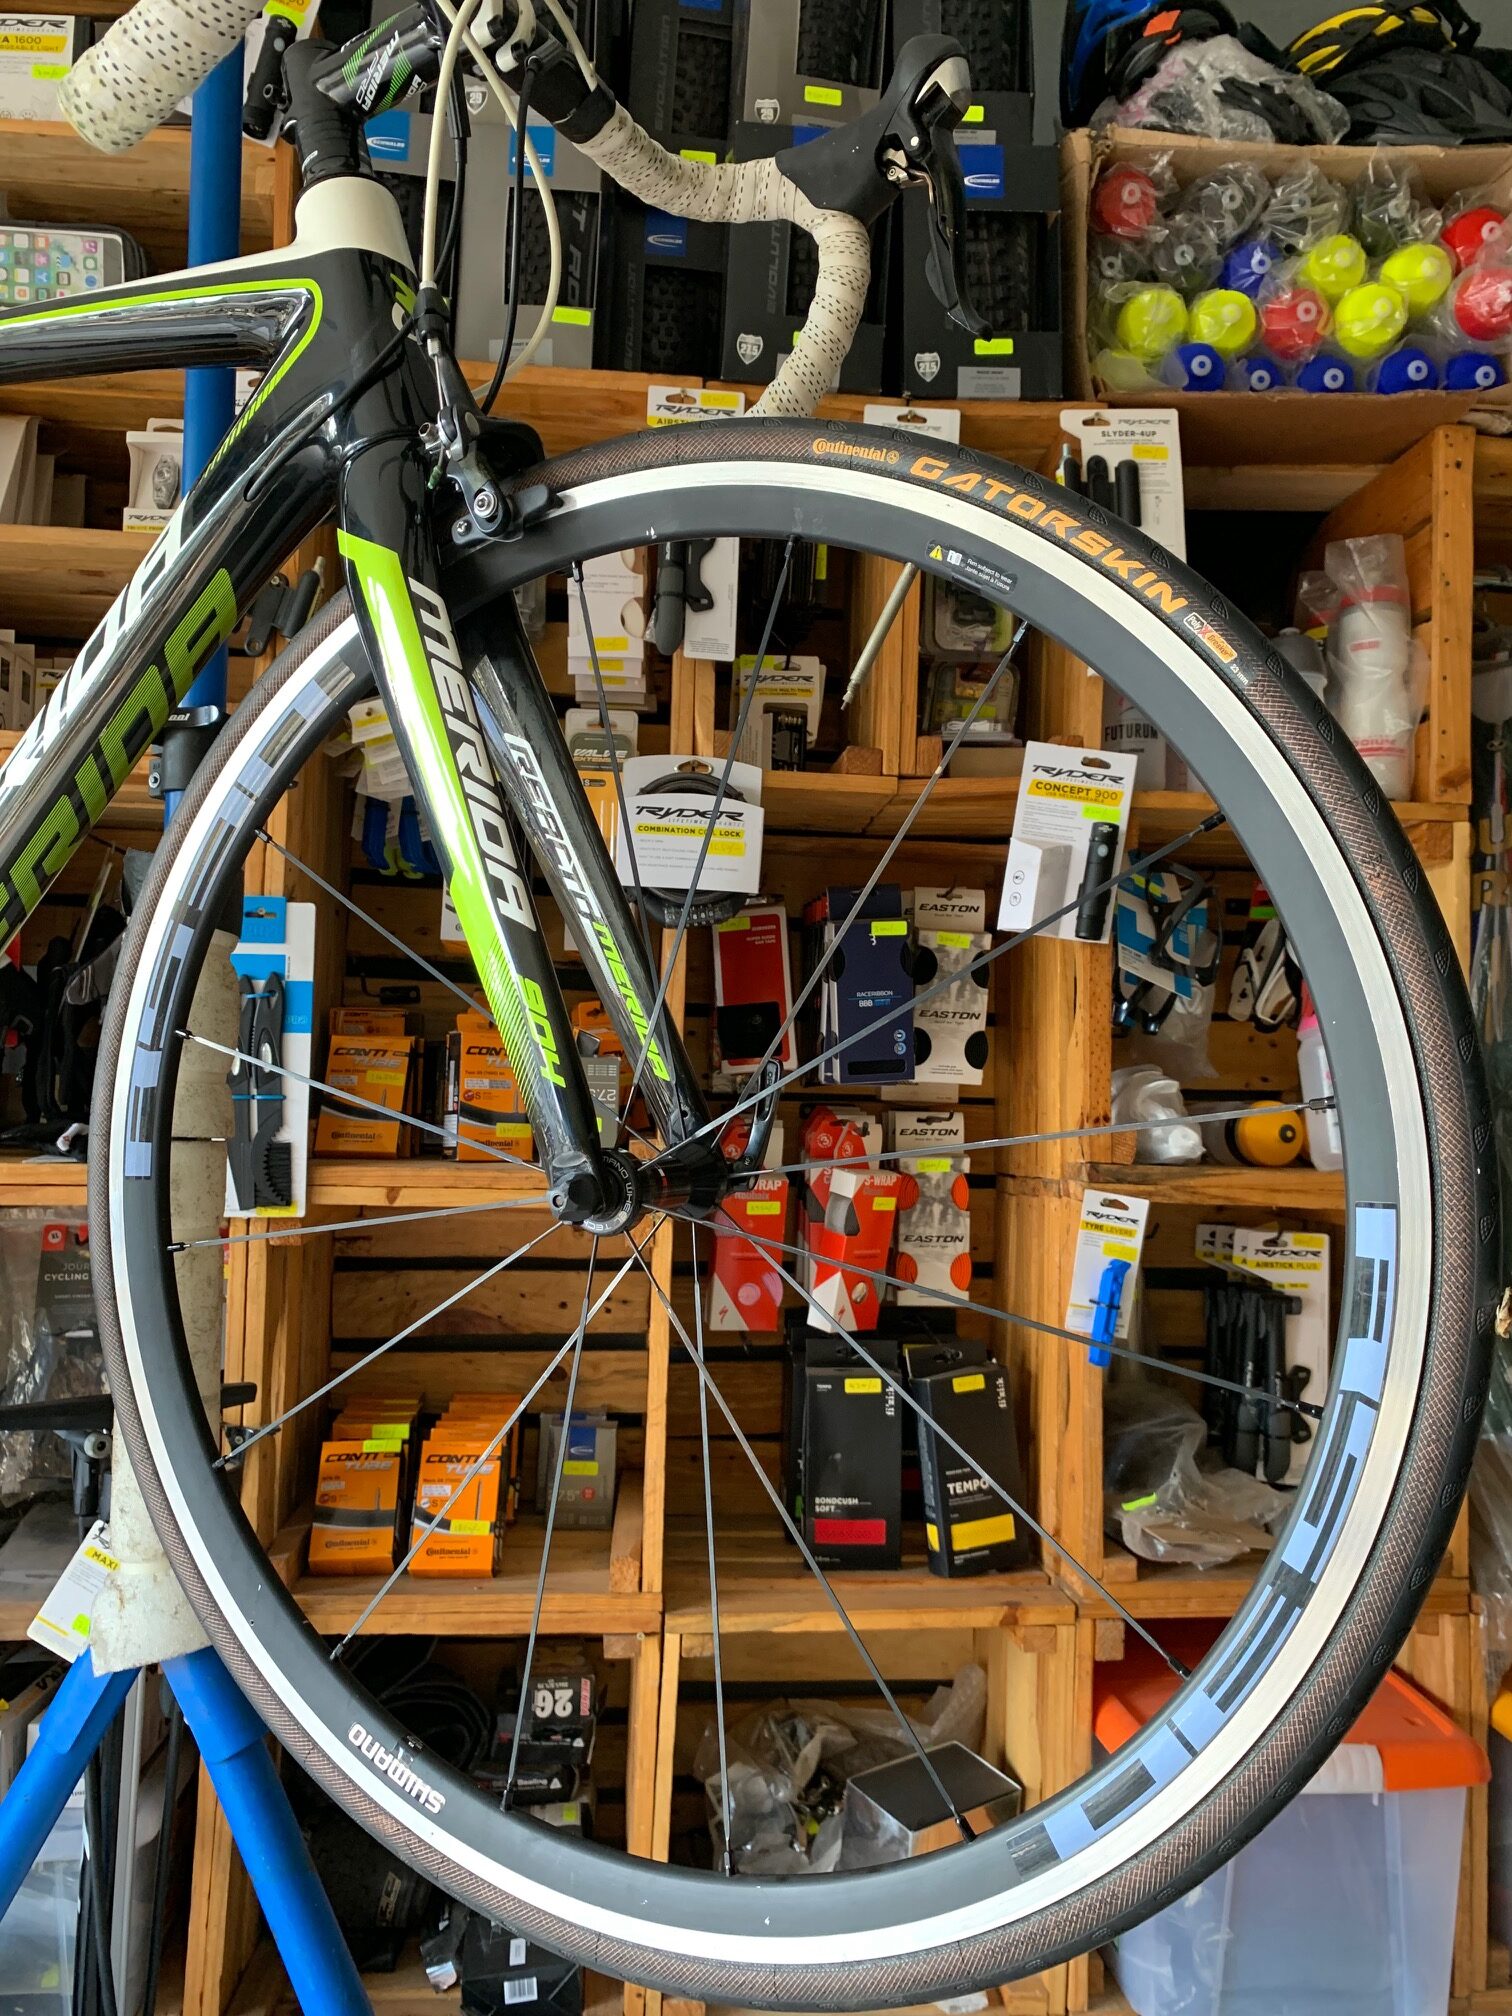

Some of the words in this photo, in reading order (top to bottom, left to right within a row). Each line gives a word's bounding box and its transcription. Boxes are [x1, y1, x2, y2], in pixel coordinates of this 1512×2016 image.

[0, 18, 67, 29] DER
[15, 36, 42, 45] 1600
[361, 29, 400, 112] MERIDA
[469, 92, 482, 104] 29
[759, 108, 774, 120] 29
[767, 219, 785, 315] EVOLUTI
[655, 403, 736, 417] RYDER
[1101, 430, 1157, 438] SLYDER-4UP
[812, 437, 887, 463] Continental
[128, 513, 172, 523] RYDE
[909, 455, 1188, 615] GATORSKIN
[743, 673, 815, 684] RYDER
[167, 712, 190, 722] ool
[1104, 723, 1158, 742] FUTURUM
[407, 575, 537, 932] MERIDA
[1031, 764, 1126, 785] RYDER
[1035, 781, 1091, 797] CONCEPT
[1095, 790, 1118, 801] 900
[635, 805, 744, 822] RYDER
[637, 825, 696, 835] COMBINATION
[719, 830, 741, 838] LOCK
[918, 903, 981, 913] EASTON
[590, 920, 671, 1082] MERIDA
[918, 1010, 981, 1020] EASTON
[516, 977, 567, 1089] 904
[333, 1047, 388, 1057] CONTI
[465, 1046, 509, 1056] CONT
[899, 1128, 960, 1136] EASTON
[864, 1174, 898, 1187] S-WRAP
[1086, 1210, 1139, 1225] RYDER
[1085, 1221, 1104, 1232] TYRE
[1105, 1225, 1133, 1237] LEVERS
[903, 1234, 964, 1244] EASTON
[1254, 1248, 1322, 1258] RYDER
[63, 1263, 90, 1272] JOUR
[1255, 1261, 1294, 1269] AIRSTICK
[1296, 1262, 1318, 1270] PLUS
[44, 1272, 89, 1281] CYCLING
[325, 1452, 379, 1463] CONTI
[344, 1460, 393, 1471] TUBE
[946, 1478, 990, 1496] TEMPO
[814, 1505, 836, 1513] SOFT
[425, 1547, 471, 1557] Continental
[91, 1551, 119, 1571] MAXI
[534, 1687, 574, 1719] 26
[347, 1722, 447, 1814] SHIMANO
